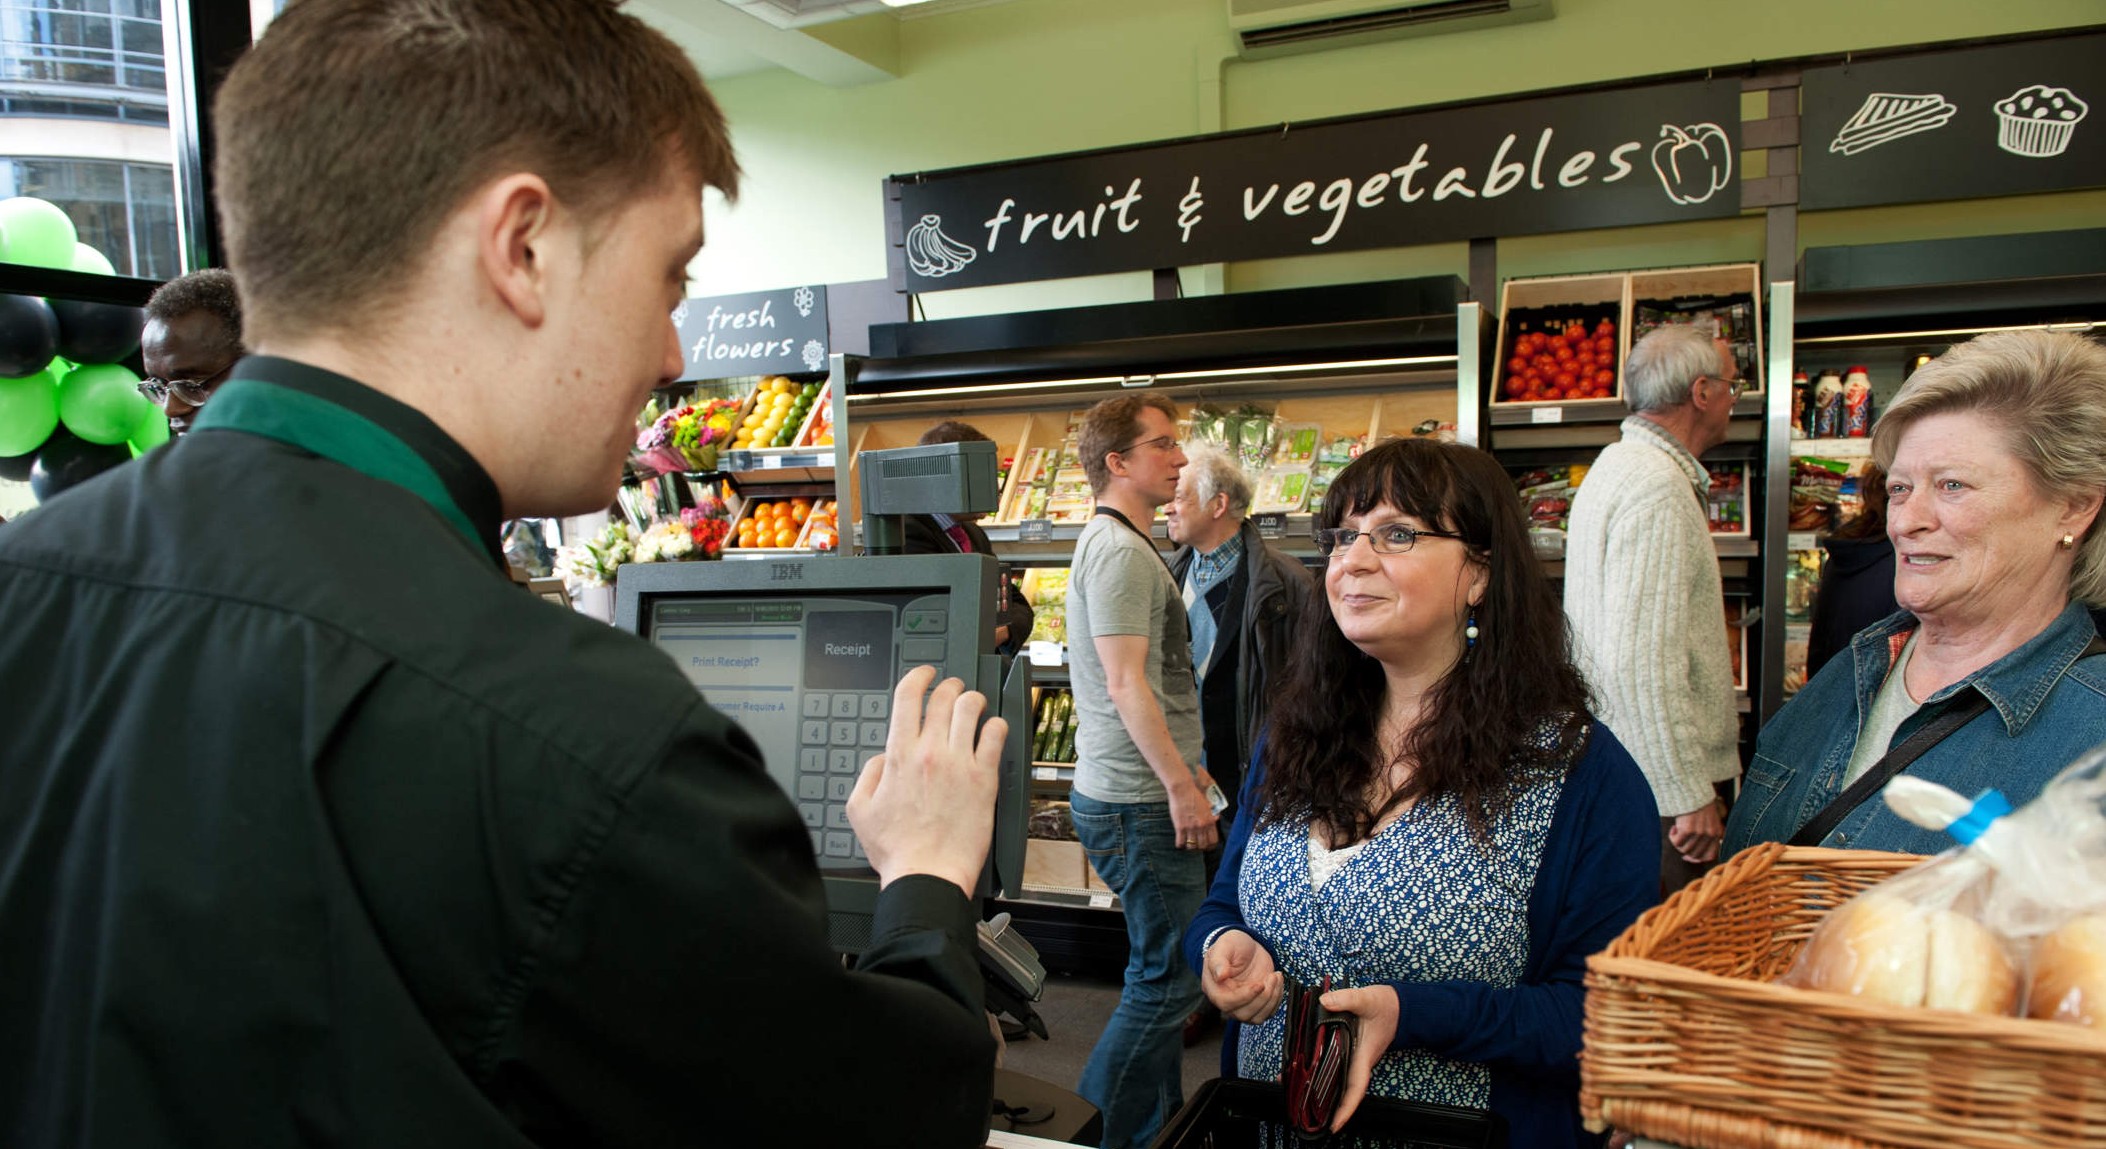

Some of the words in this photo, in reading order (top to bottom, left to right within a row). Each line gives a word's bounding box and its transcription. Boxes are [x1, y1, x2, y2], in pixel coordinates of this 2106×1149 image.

[984, 177, 1142, 252] fruit
[1177, 176, 1203, 243] &
[1243, 127, 1641, 245] vegetables
[706, 300, 776, 332] fresh
[692, 334, 794, 363] flowers
[771, 563, 804, 580] IBM
[825, 643, 871, 657] Receipt
[692, 656, 715, 667] Print
[718, 656, 760, 669] Receipt?
[743, 702, 776, 712] Require
[778, 702, 785, 711] A
[813, 700, 820, 712] 7
[841, 701, 850, 713] 8
[871, 701, 879, 713] 9
[811, 727, 819, 740] 4
[841, 728, 848, 741] 5
[870, 729, 877, 742] 6
[839, 756, 847, 768] 2
[838, 783, 845, 795] 0
